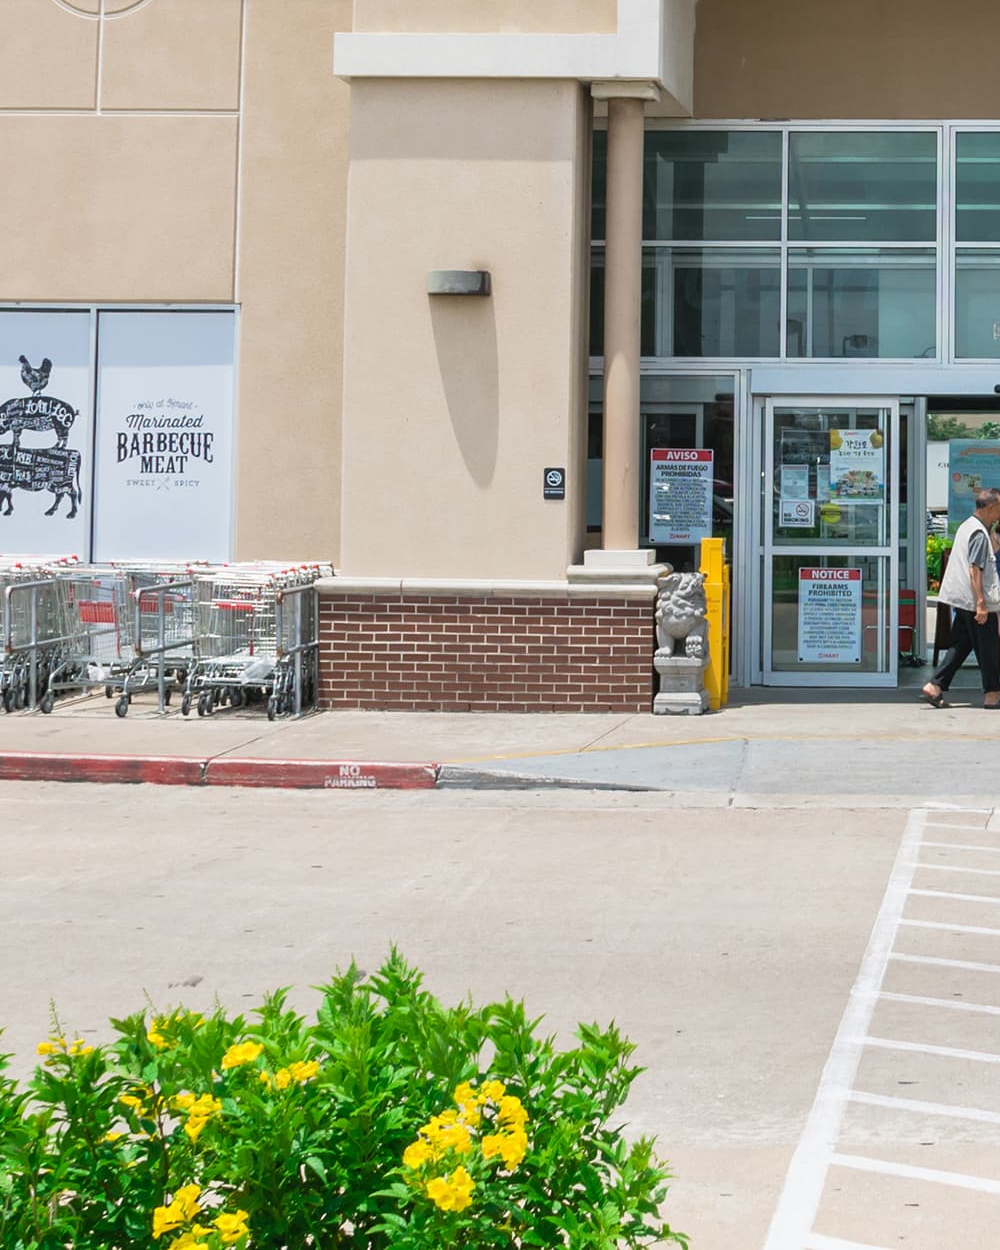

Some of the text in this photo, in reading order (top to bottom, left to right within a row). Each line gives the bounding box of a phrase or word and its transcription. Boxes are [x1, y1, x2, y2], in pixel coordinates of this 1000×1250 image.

[126, 414, 204, 431] Marinated
[117, 432, 213, 463] BARBECUE
[666, 451, 698, 460] AVISO
[140, 455, 188, 474] MEAT
[811, 571, 849, 579] NOTICE
[339, 765, 360, 776] NO
[324, 776, 376, 788] PARKING
